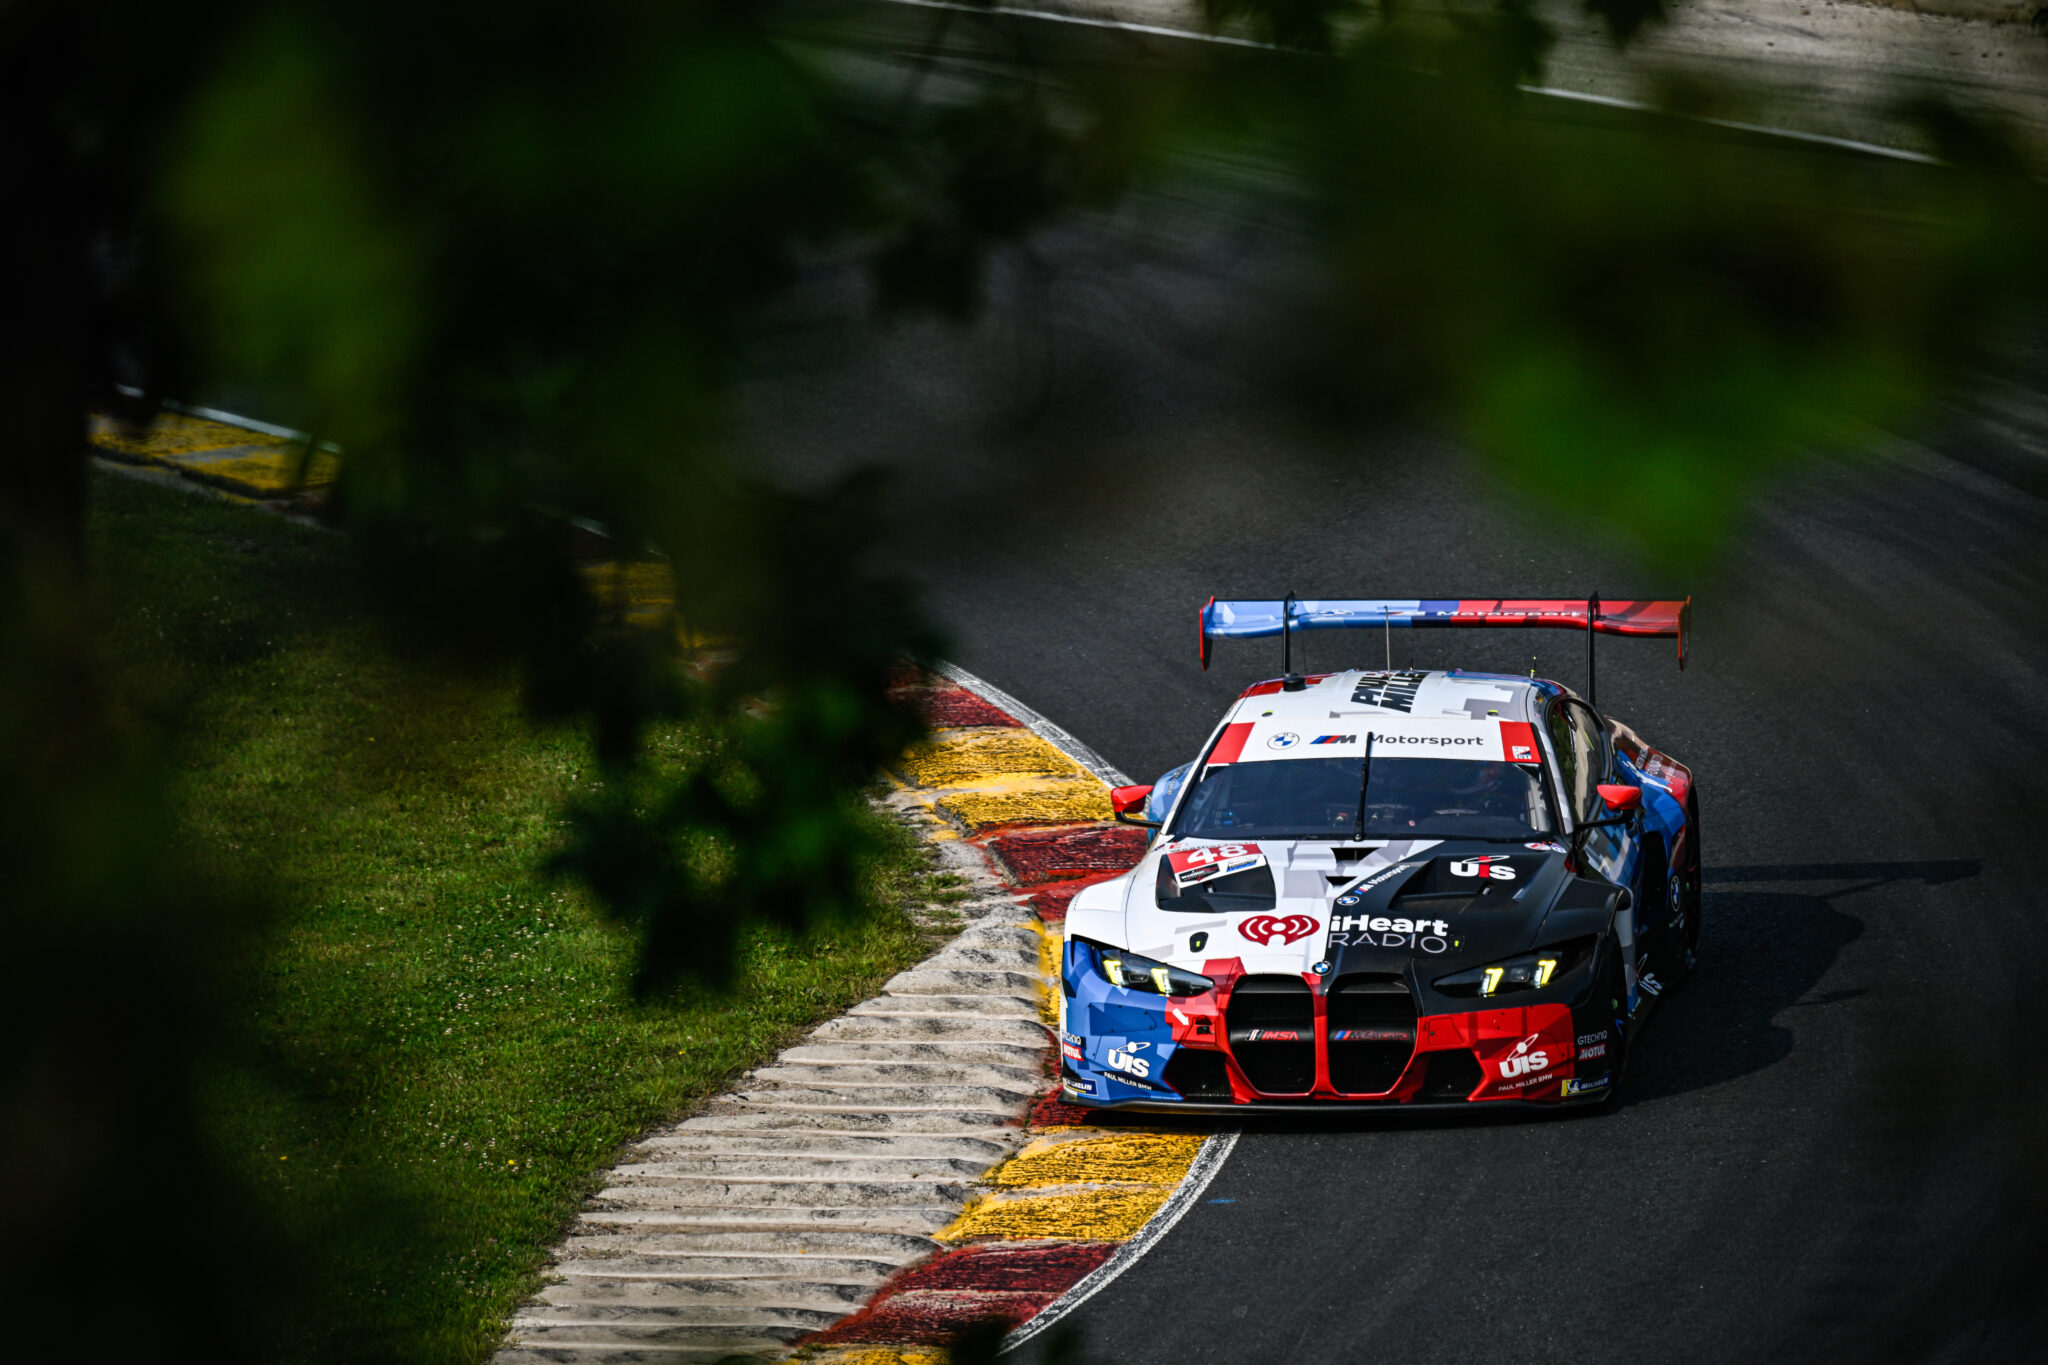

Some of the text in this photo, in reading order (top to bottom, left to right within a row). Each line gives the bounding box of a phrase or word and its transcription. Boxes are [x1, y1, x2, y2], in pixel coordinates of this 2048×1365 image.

[1371, 734, 1484, 746] Motorsport
[1187, 845, 1248, 864] 48
[1330, 914, 1449, 937] iHeart
[1328, 932, 1448, 953] RADIO
[1262, 1031, 1299, 1041] IMSA
[1579, 1044, 1606, 1060] MOTUL
[1515, 1078, 1538, 1088] MILLER
[1538, 1073, 1553, 1082] BMW
